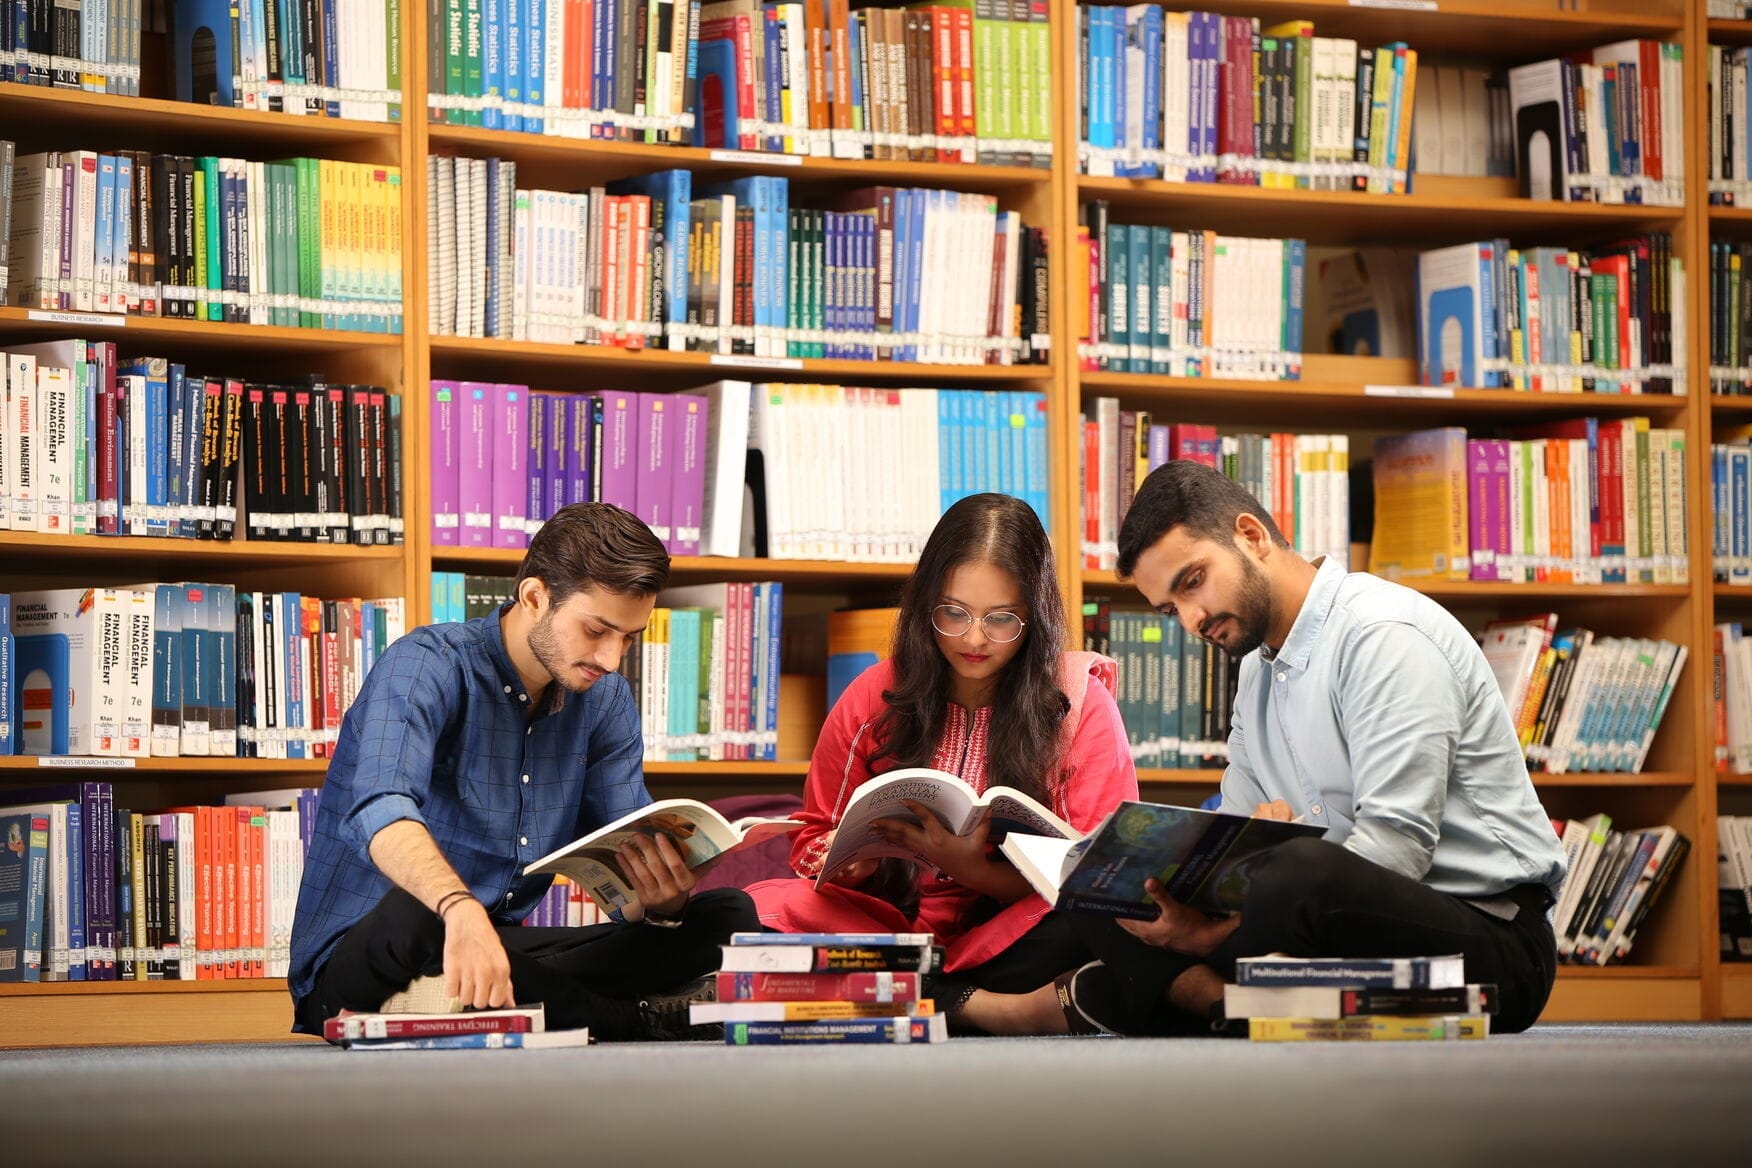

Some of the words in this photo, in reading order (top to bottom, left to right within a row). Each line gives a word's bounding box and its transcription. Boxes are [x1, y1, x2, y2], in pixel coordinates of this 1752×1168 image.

[449, 11, 461, 56] Statistics
[468, 13, 480, 57] Statistics
[489, 24, 499, 73] Statistics
[509, 27, 519, 75] Statistics
[531, 29, 541, 78] Statistics
[688, 41, 698, 79] BLUEPRINT
[170, 173, 178, 208] Financial
[185, 174, 193, 209] Financial
[167, 210, 178, 256] Management
[183, 211, 194, 257] Management
[653, 247, 664, 278] GROW
[20, 396, 30, 434] FINANCIAL
[106, 393, 114, 427] Business
[157, 387, 165, 413] Research
[190, 390, 200, 433] Multinational
[226, 395, 234, 437] Cost-Benefit
[49, 391, 58, 464] MANAGEMENT
[58, 392, 66, 446] FINANCIAL
[157, 416, 165, 444] Methods
[21, 435, 31, 488] MANAGEMENT
[106, 429, 114, 482] Environment
[189, 434, 198, 464] Financial
[211, 430, 219, 461] Research
[224, 439, 232, 468] Analysis
[232, 432, 240, 462] Research
[49, 474, 60, 484] 7e
[156, 453, 165, 476] Applied
[155, 478, 164, 503] Settings
[17, 613, 58, 621] MANAGEMENT
[103, 613, 112, 685] MANAGEMENT
[112, 614, 120, 667] FINANCIAL
[131, 615, 141, 687] MANAGEMENT
[141, 616, 149, 668] FINANCIAL
[1, 637, 9, 680] Qualitative
[1, 682, 9, 719] Research
[103, 696, 113, 705] 7e
[131, 697, 141, 706] 7e
[869, 792, 940, 808] MANAGEMENT
[33, 857, 41, 883] Financial
[136, 859, 144, 880] EVERY
[168, 848, 176, 859] KEY
[37, 857, 45, 896] International
[203, 865, 211, 900] Effective
[216, 866, 224, 901] Effective
[228, 864, 236, 898] Effective
[242, 866, 250, 901] Effective
[254, 864, 262, 899] Effective
[31, 884, 40, 922] Management
[203, 903, 211, 935] Training
[216, 904, 224, 936] Training
[228, 902, 236, 933] Training
[242, 904, 250, 936] Training
[254, 902, 262, 933] Training
[761, 976, 815, 991] FUNDAMENTALS
[776, 986, 815, 994] MARKETING
[1251, 967, 1305, 977] Multinational
[1306, 967, 1342, 977] Financial
[1343, 968, 1393, 980] Managemen
[413, 1021, 454, 1032] TRAINING
[457, 1019, 499, 1031] EFFECTIVE
[749, 1027, 782, 1035] FINANCIAL
[783, 1026, 827, 1034] INSTITUTIONS
[828, 1025, 876, 1033] MANAGEMENT
